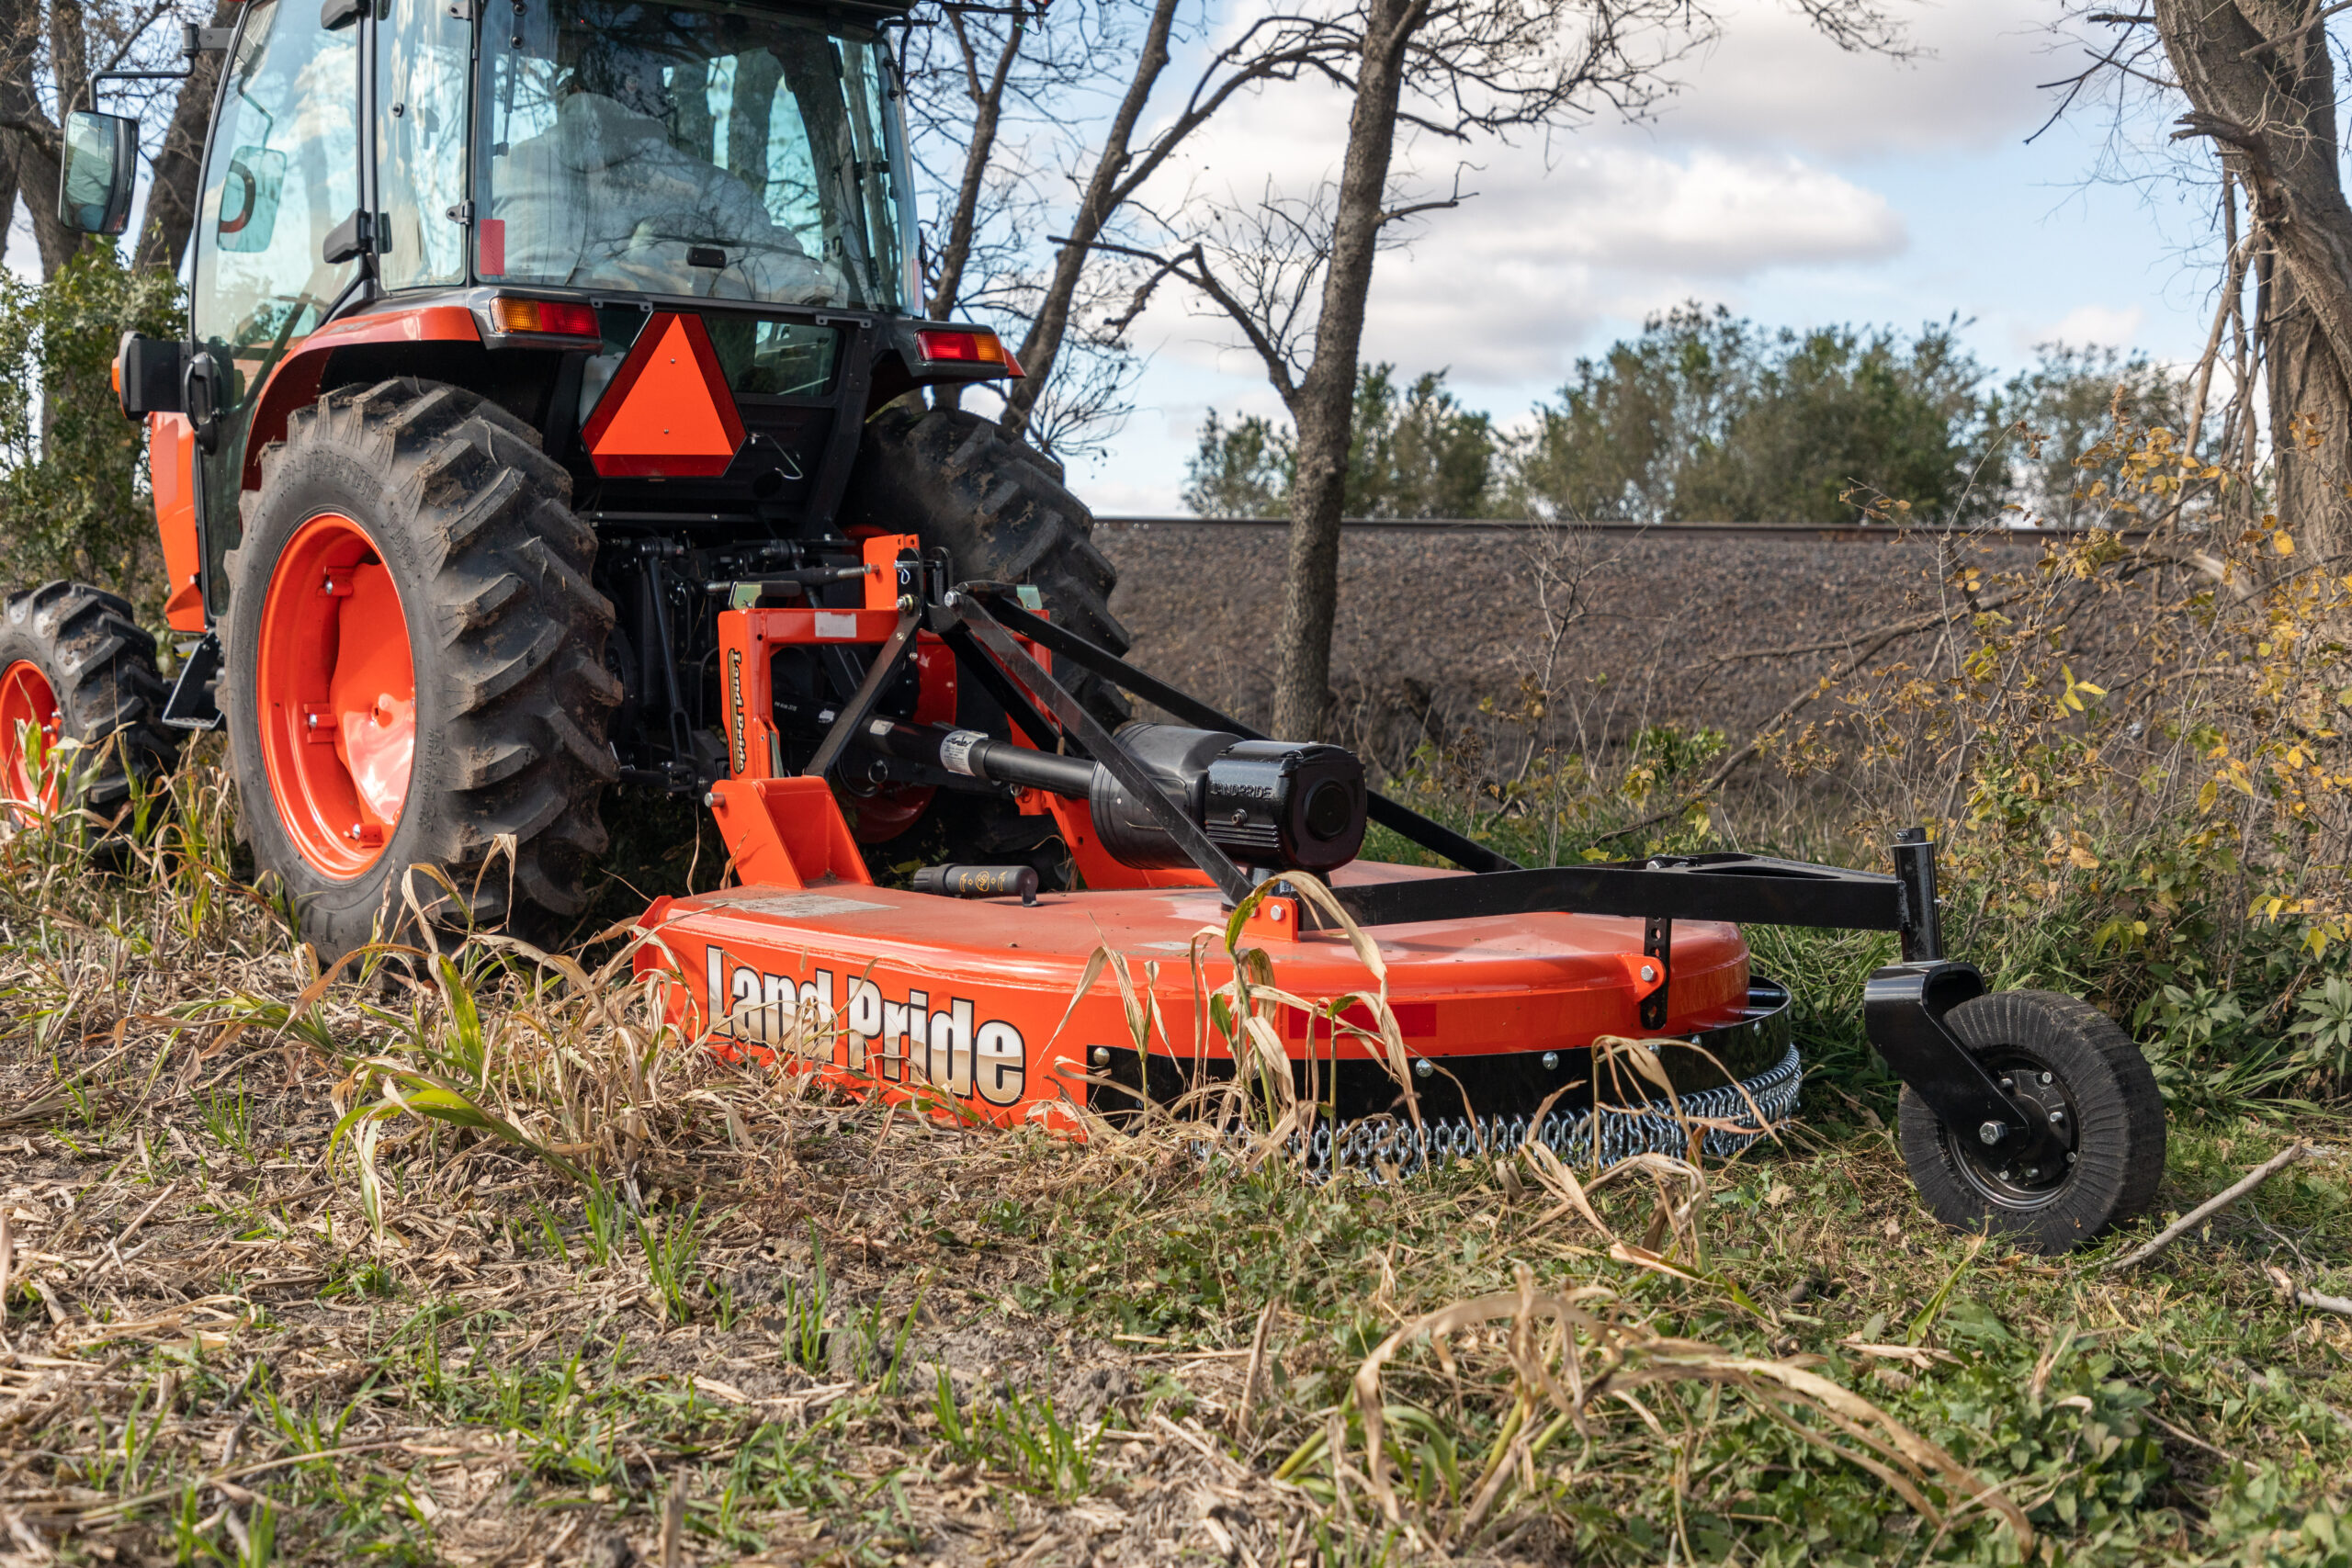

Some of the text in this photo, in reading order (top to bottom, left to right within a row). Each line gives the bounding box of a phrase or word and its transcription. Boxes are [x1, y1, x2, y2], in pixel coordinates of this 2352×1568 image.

[732, 650, 746, 771] Land Pride
[707, 944, 1026, 1107] Land Pride
